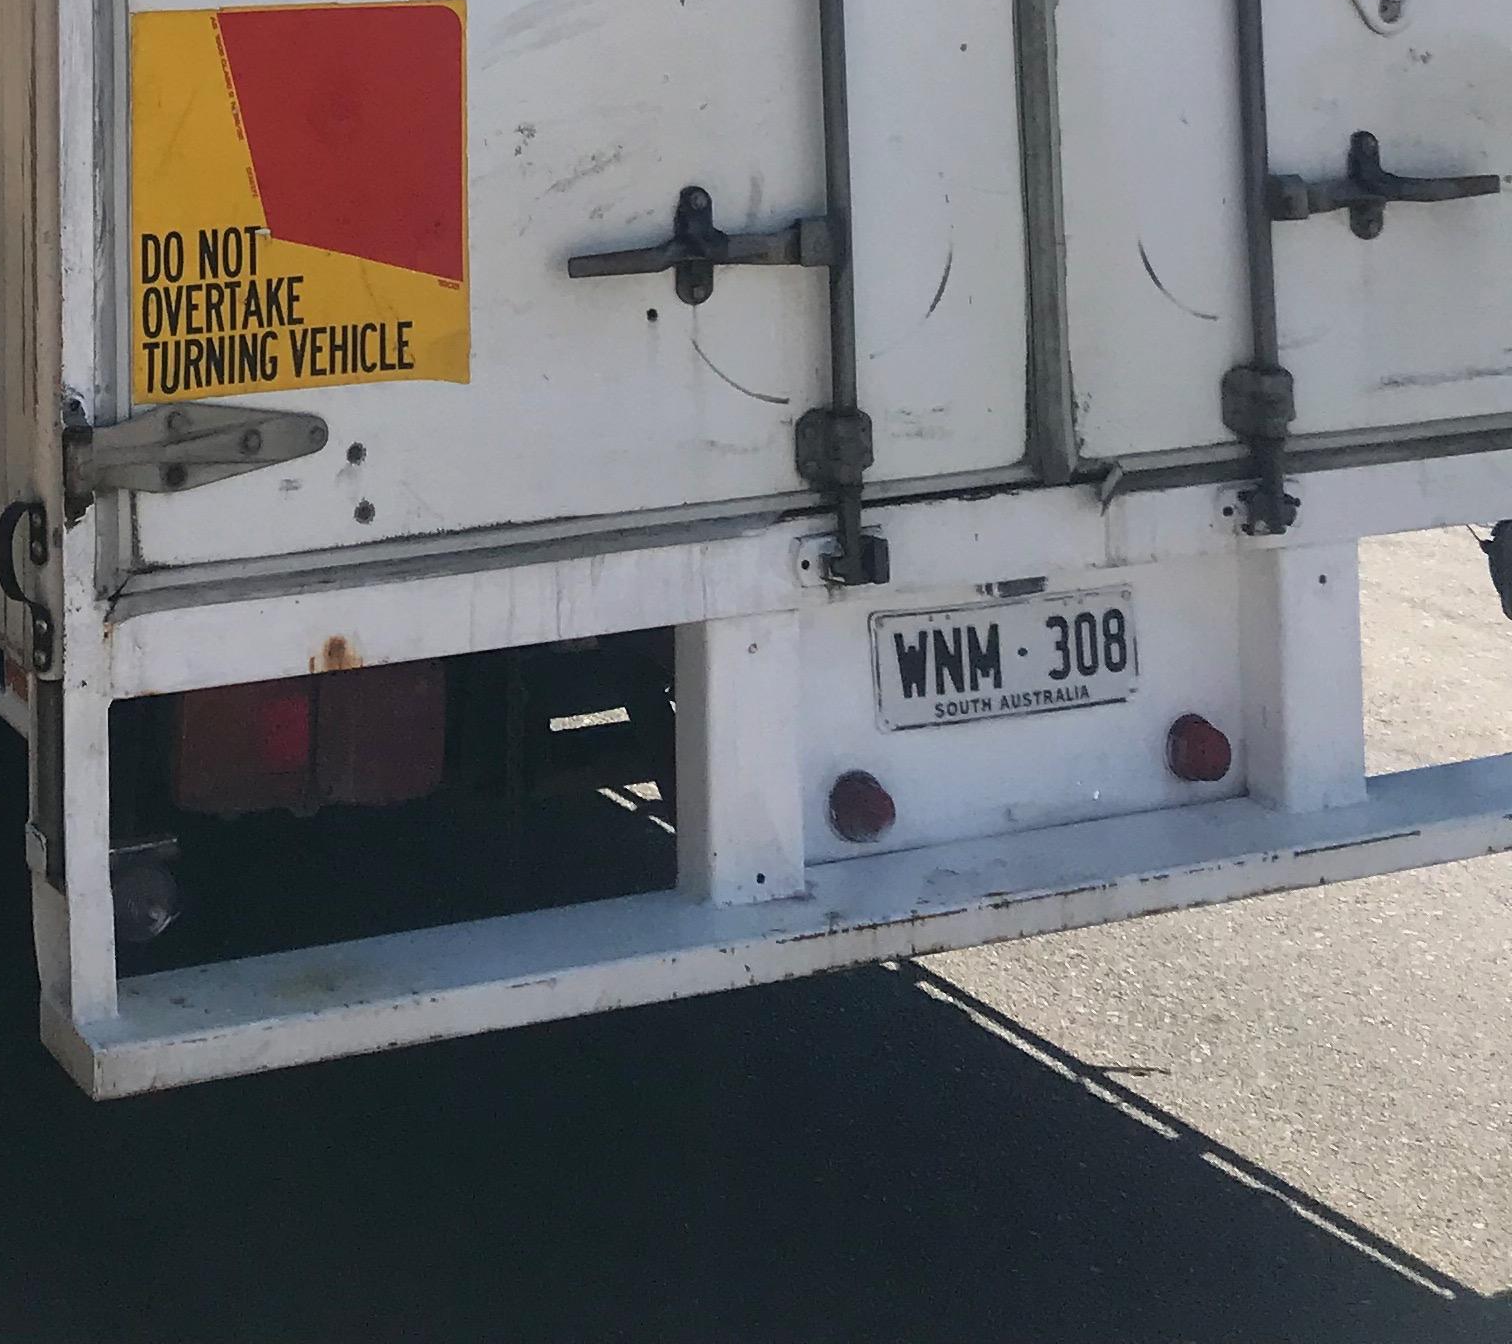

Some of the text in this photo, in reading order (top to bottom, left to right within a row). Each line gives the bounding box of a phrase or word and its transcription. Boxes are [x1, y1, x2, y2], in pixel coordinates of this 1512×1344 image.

[141, 226, 261, 284] DO NOT
[141, 275, 305, 339] OVERTAKE
[143, 320, 415, 395] TURNING VEHICLE
[893, 608, 1127, 699] WNM 308
[934, 684, 1090, 719] SOUTH AUSTRALIA
